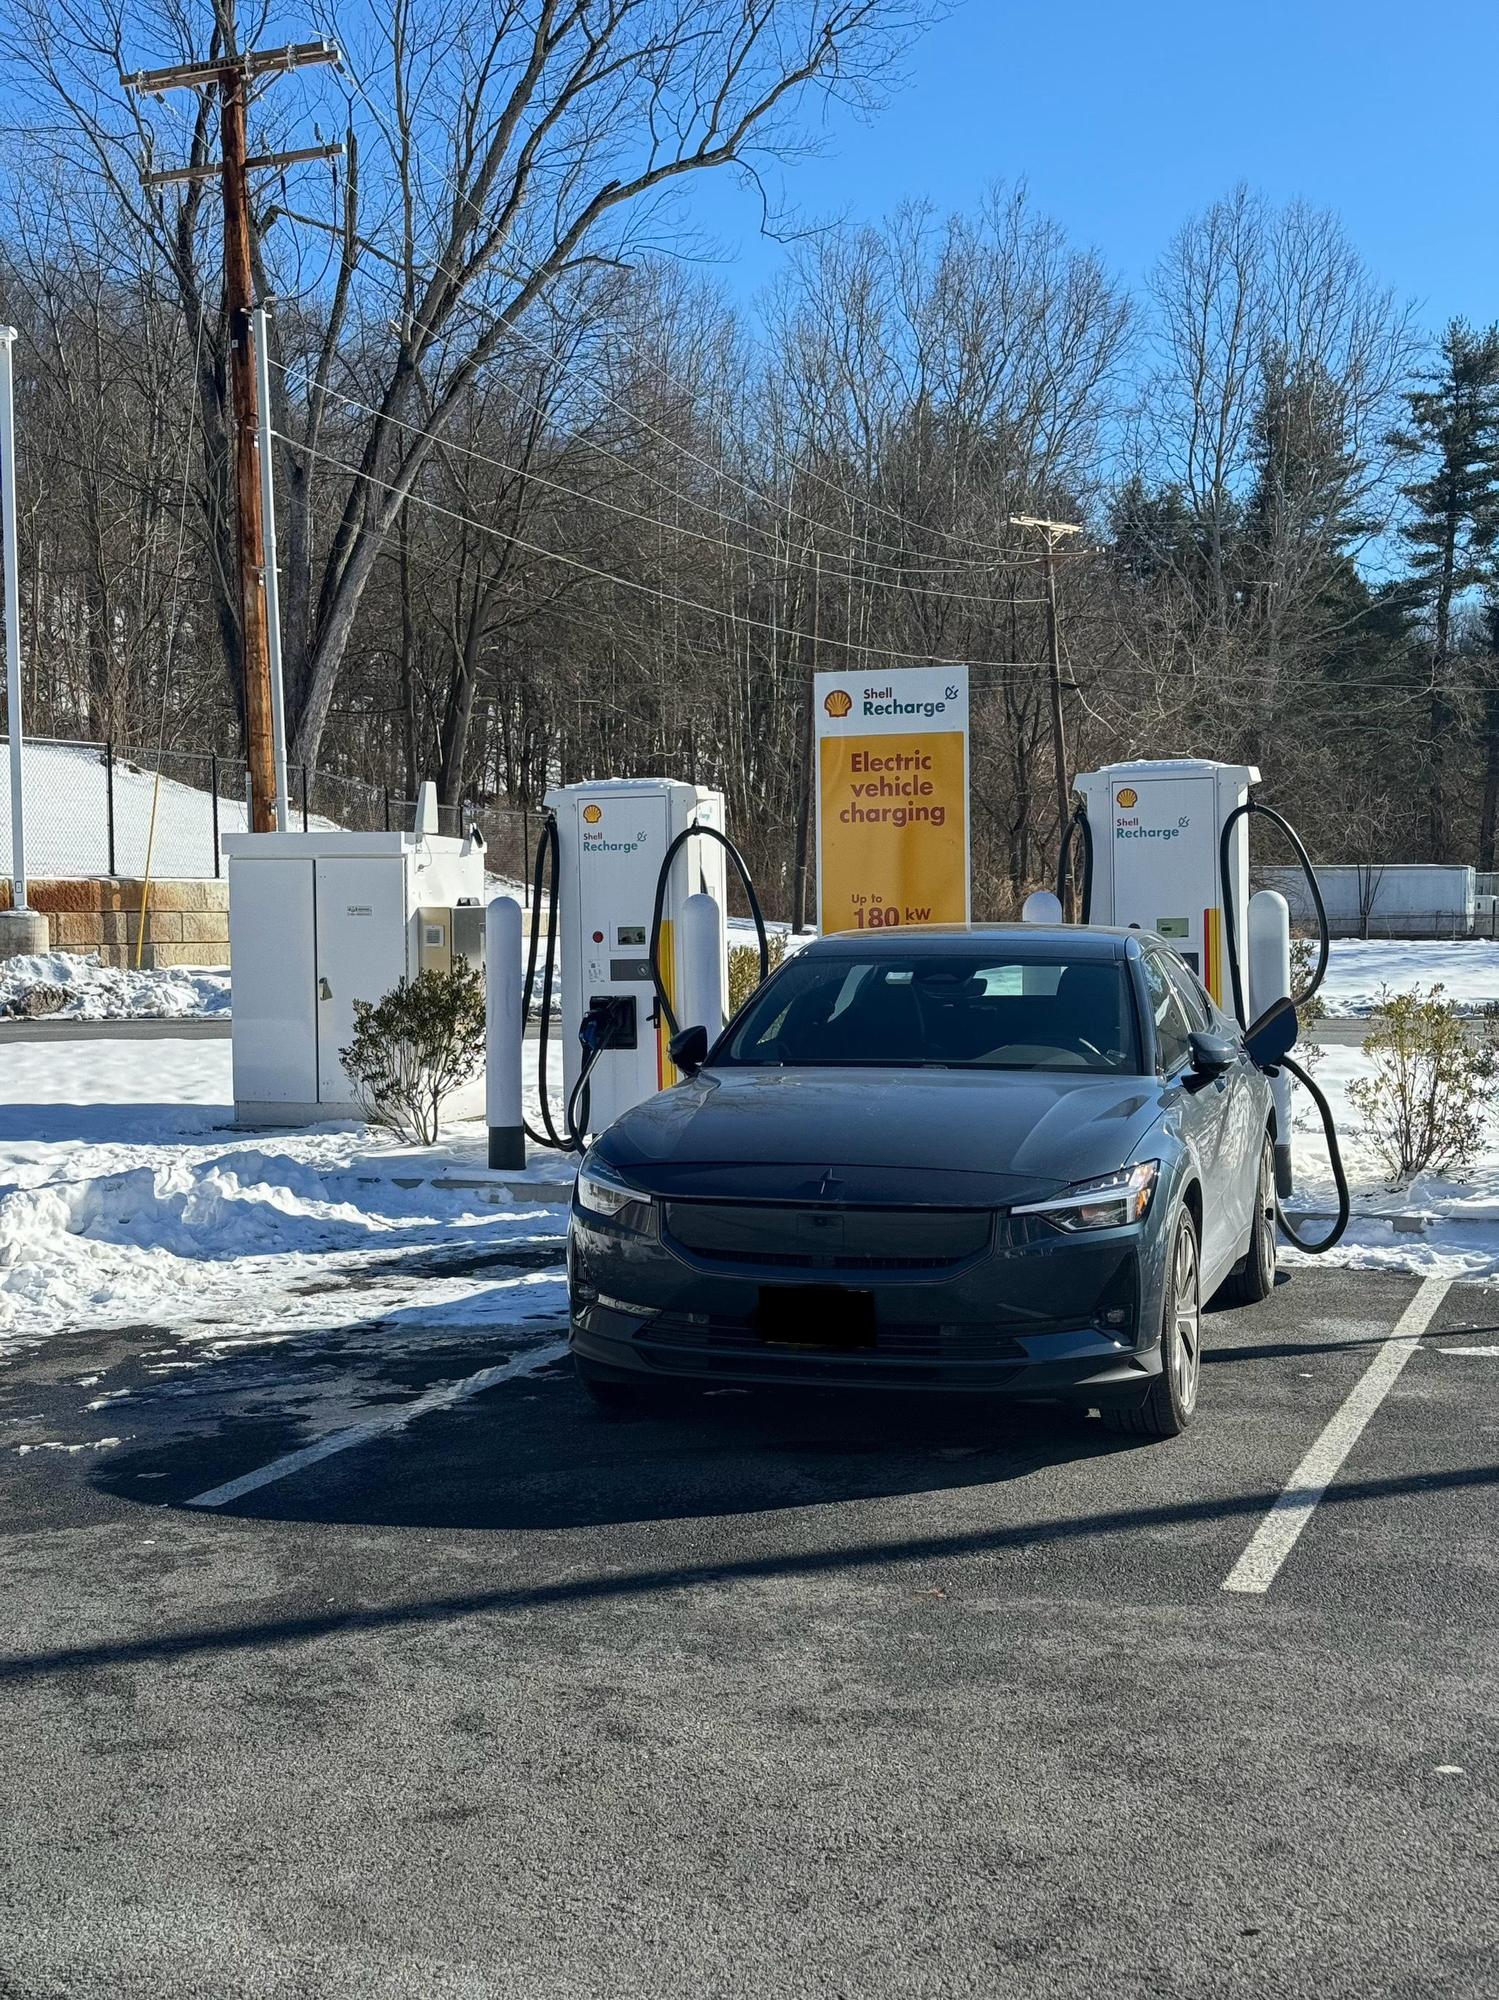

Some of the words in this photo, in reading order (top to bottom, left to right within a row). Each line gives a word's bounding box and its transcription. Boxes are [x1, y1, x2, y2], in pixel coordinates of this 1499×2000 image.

[863, 687, 892, 699] Shell
[863, 698, 946, 717] Recharge
[851, 750, 932, 773] Electric
[850, 775, 934, 798] vehicle
[839, 800, 945, 827] charging
[1116, 817, 1139, 827] Shell
[583, 832, 603, 841] Shell
[1116, 826, 1180, 840] Recharge
[583, 840, 638, 853] Recharge
[851, 894, 867, 906] Up
[871, 894, 883, 903] to
[853, 906, 900, 928] 180
[905, 907, 932, 921] kW
